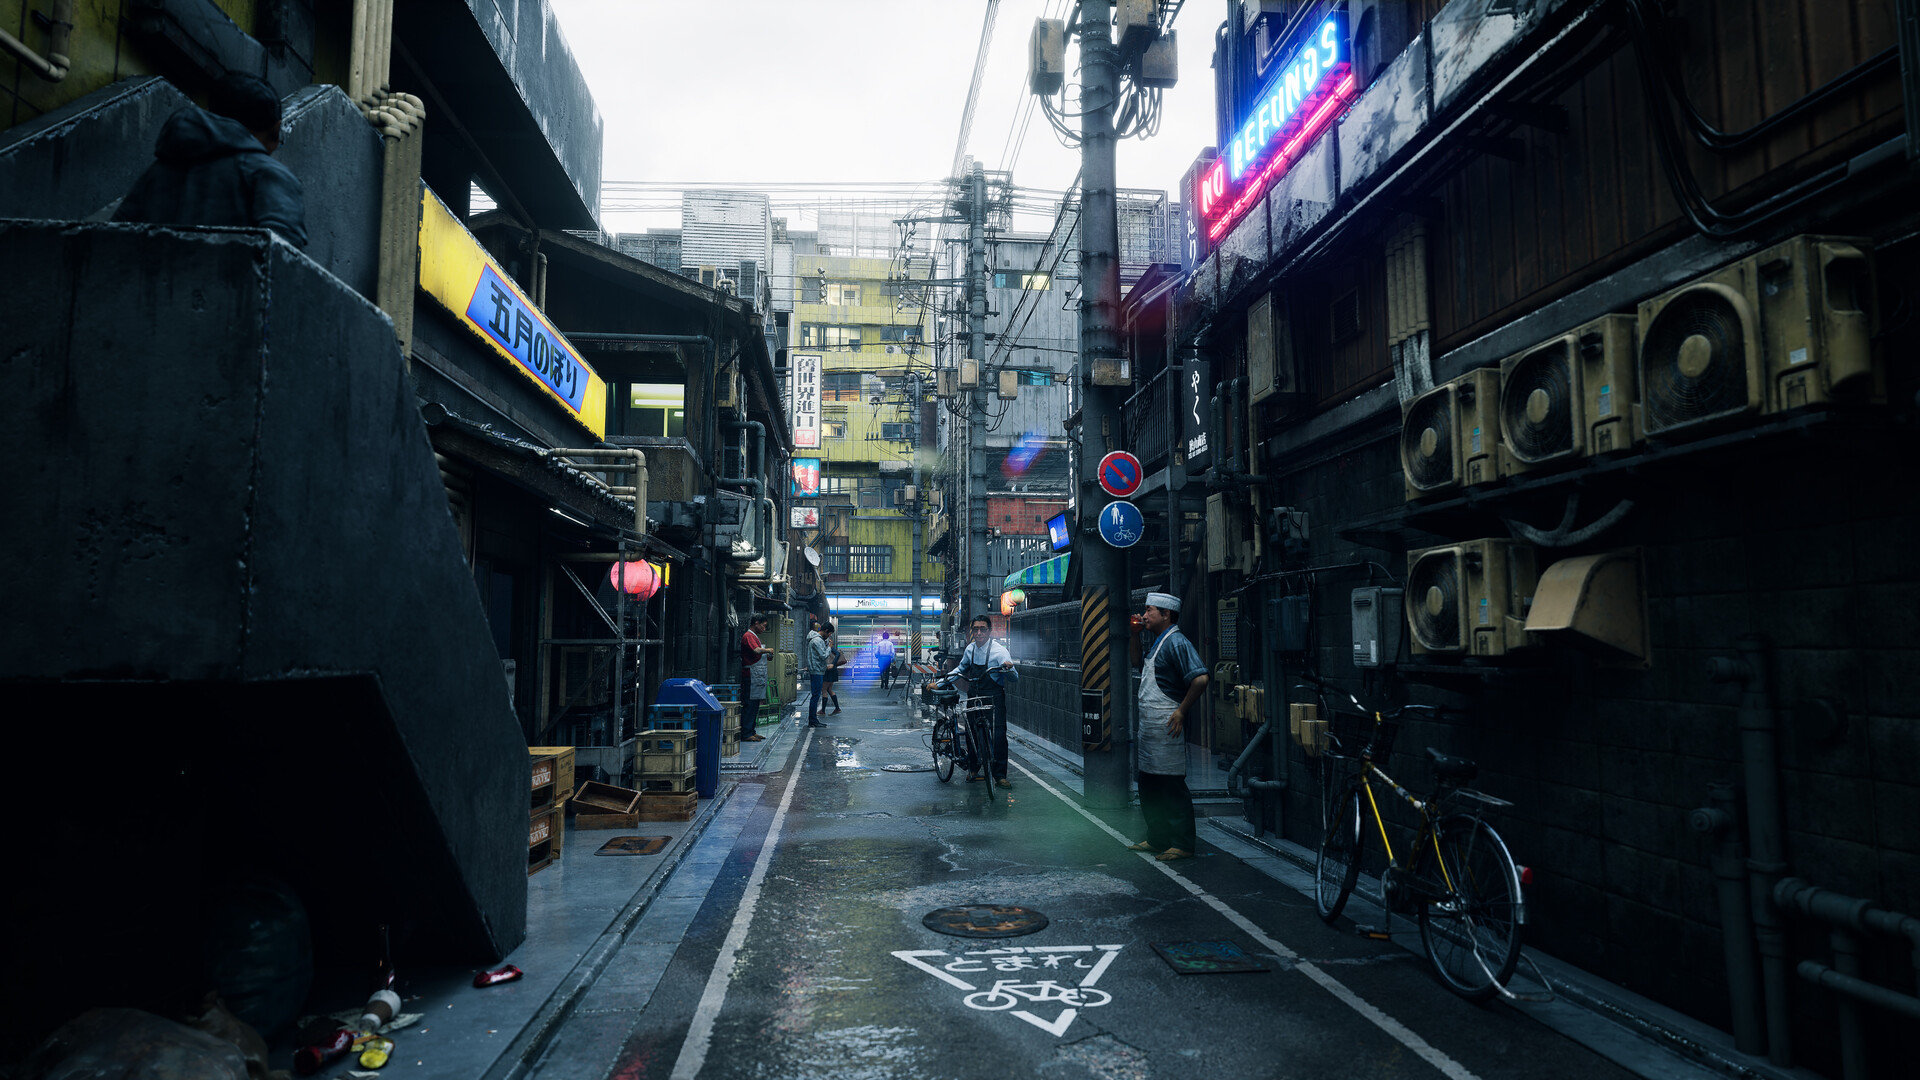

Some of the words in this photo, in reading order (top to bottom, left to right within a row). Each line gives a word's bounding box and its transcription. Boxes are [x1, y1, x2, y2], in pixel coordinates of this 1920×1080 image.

[1201, 162, 1226, 214] NO
[1231, 20, 1338, 179] REFUNDS
[488, 280, 578, 399] 五月のぼり
[855, 598, 888, 608] MiniRush
[944, 953, 1095, 972] とまれ
